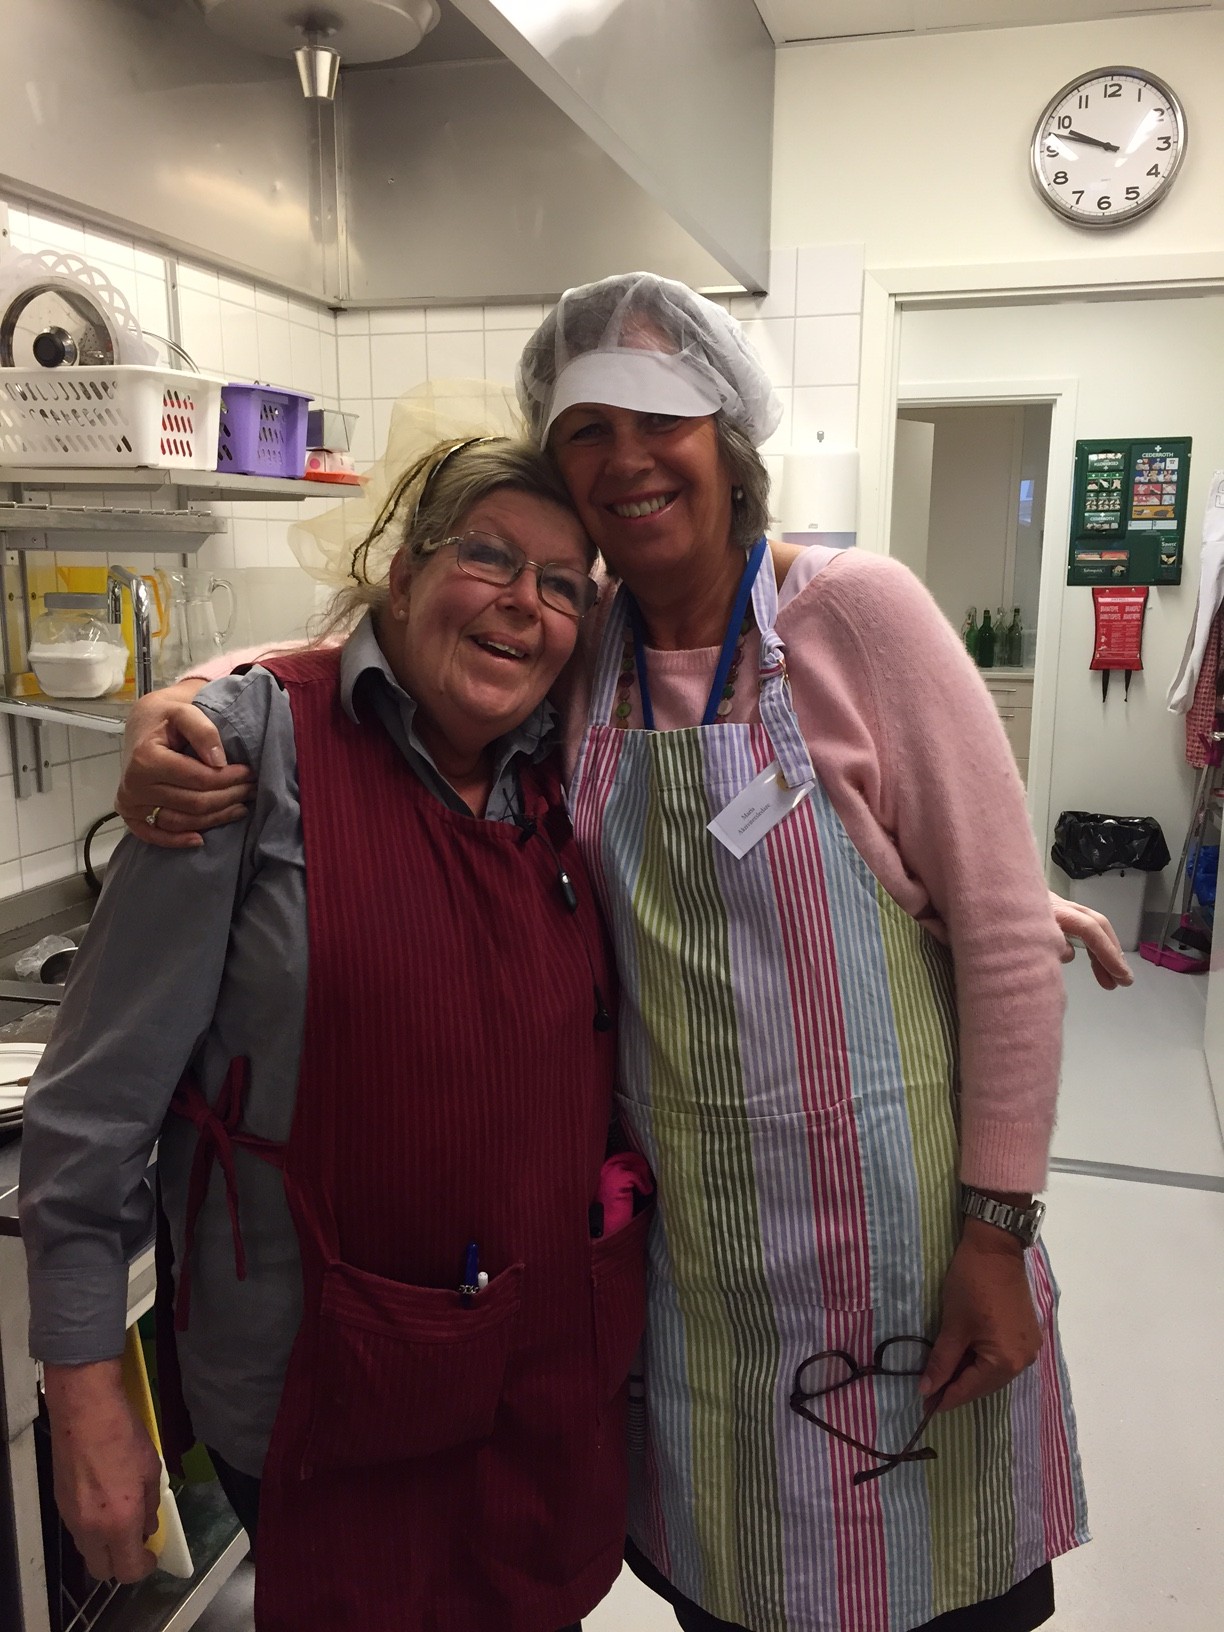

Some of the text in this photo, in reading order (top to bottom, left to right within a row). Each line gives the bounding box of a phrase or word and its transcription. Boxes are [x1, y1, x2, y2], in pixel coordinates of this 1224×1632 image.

[1103, 83, 1122, 98] 12
[1137, 88, 1142, 102] 1
[1078, 95, 1089, 109] 11
[1057, 115, 1073, 129] 10
[1156, 136, 1171, 151] 3
[1146, 164, 1160, 177] 4
[1053, 171, 1068, 185] 8
[1072, 190, 1084, 205] 7
[1125, 186, 1140, 200] 5
[1097, 196, 1111, 210] 6
